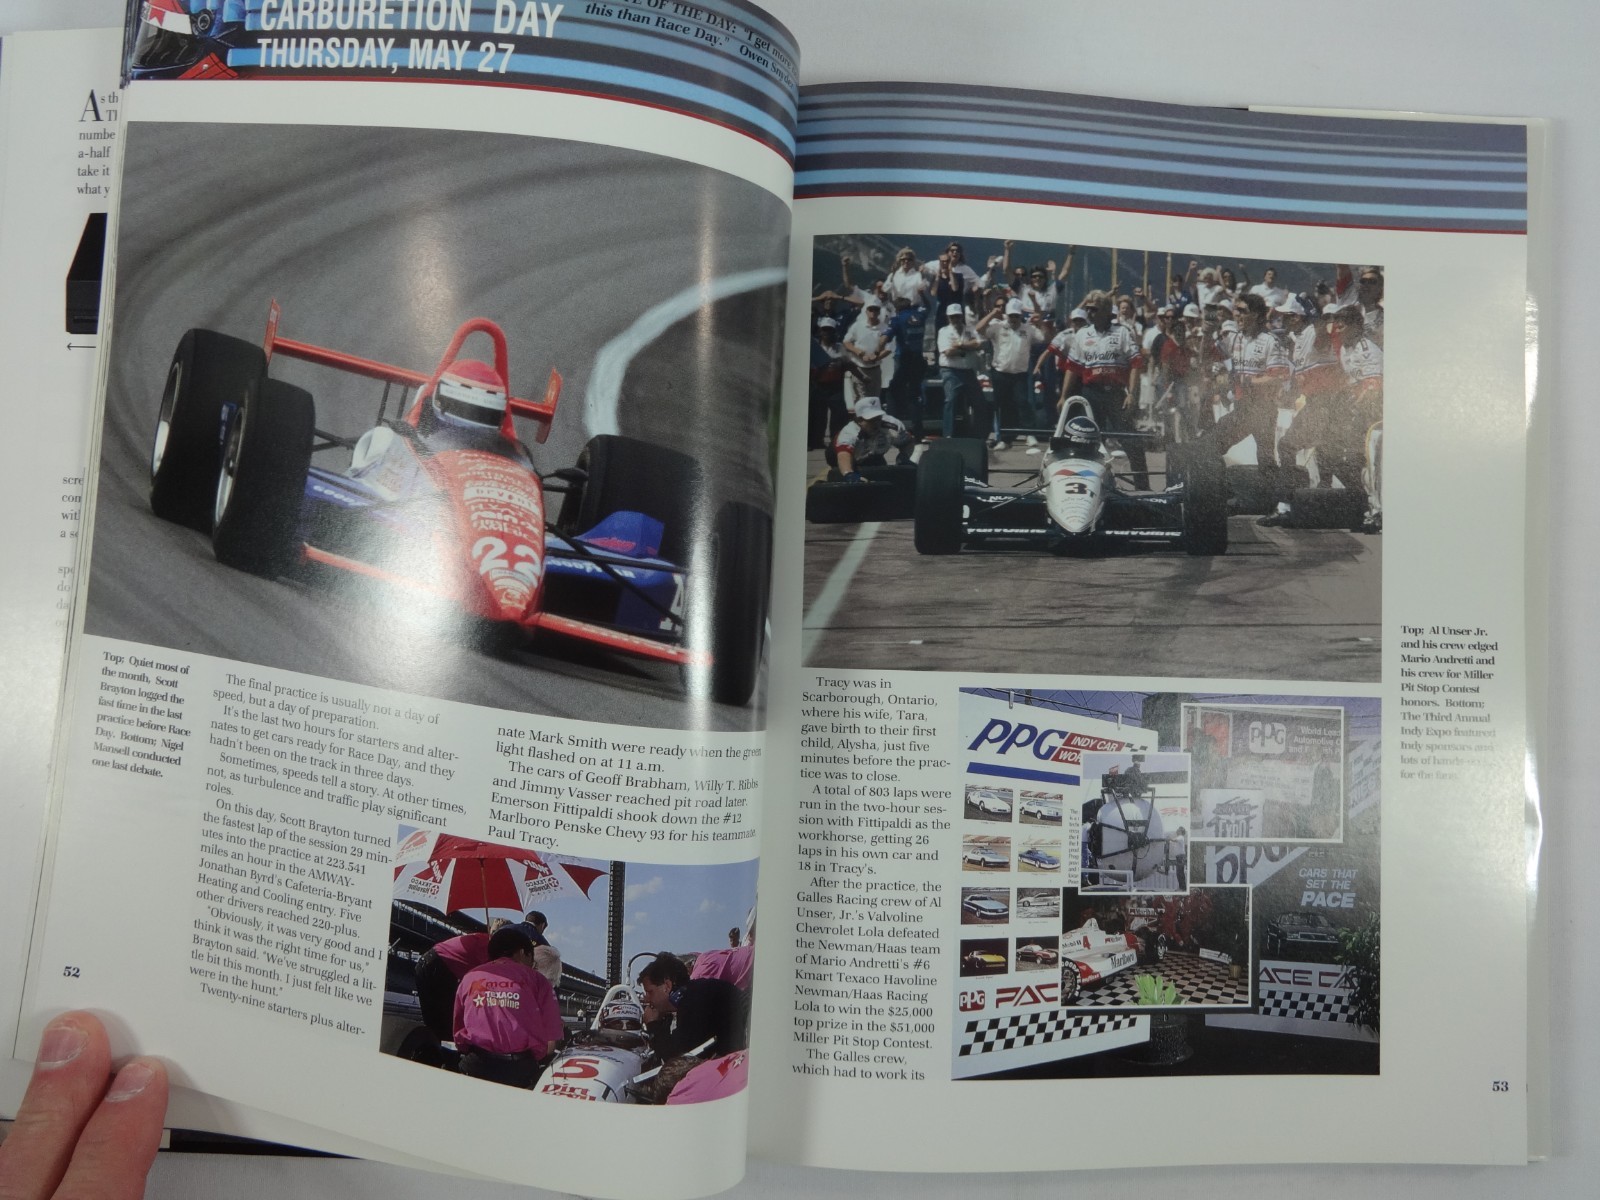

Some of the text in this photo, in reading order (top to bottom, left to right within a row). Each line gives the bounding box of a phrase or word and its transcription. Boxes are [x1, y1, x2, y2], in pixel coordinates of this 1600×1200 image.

[261, 0, 563, 38] CARBURETION DAY
[673, 3, 703, 21] THE
[706, 14, 737, 33] DAY:
[754, 34, 771, 51] get
[585, 3, 613, 17] this
[617, 9, 650, 24] than
[654, 16, 690, 34] Race
[739, 44, 769, 68] Owen
[257, 38, 515, 74] THURSDAY, MAY 27
[77, 165, 99, 177] take
[77, 183, 102, 195] what
[1400, 625, 1488, 636] Top; Al Unser Jr.
[1400, 639, 1420, 648] and
[1422, 639, 1438, 649] his
[1467, 641, 1498, 652] edged
[128, 655, 154, 668] Quiet
[155, 662, 178, 672] most
[179, 665, 190, 674] of
[1400, 653, 1495, 665] Mario Andretti and
[101, 666, 116, 676] the
[155, 676, 178, 688] Scott
[815, 676, 892, 690] Tracy was in
[802, 691, 937, 706] Scarborough, Ontario,
[212, 689, 378, 730] speed, but a day of preparation.
[96, 713, 191, 736] practice before Race
[967, 718, 1069, 761] PPG
[1071, 736, 1119, 752] INDY CAR
[1250, 722, 1286, 749] PPG
[209, 732, 414, 788] hadn't been on the track in three days.
[495, 740, 664, 772] light flashed on at 11 a.m.
[800, 754, 950, 770] minutes before the prac-
[812, 784, 951, 800] A total of 803 laps were
[491, 791, 741, 824] Emerson Fittipaldi shook down the #12
[487, 825, 558, 849] Paul Tracy.
[1299, 868, 1358, 878] CARS THAT
[198, 857, 372, 909] Jonathan Byrd's Cafeteria-Bryant
[810, 876, 941, 892] After the practice, the
[1305, 880, 1351, 889] SET THE
[197, 872, 361, 922] Heating and Cooling entry. Five
[1301, 891, 1356, 908] PACE
[1082, 935, 1091, 950] 4
[63, 967, 81, 978] 52
[795, 968, 937, 986] Kmart Texaco Havoline
[485, 990, 520, 1000] TEXACO
[199, 982, 365, 1034] Twenty-nine starters plus alter-
[794, 1016, 935, 1033] top prize in the $51,000
[793, 1031, 932, 1050] Miller Pit Stop Contest.
[552, 1059, 599, 1078] 5
[1492, 1081, 1509, 1092] 53
